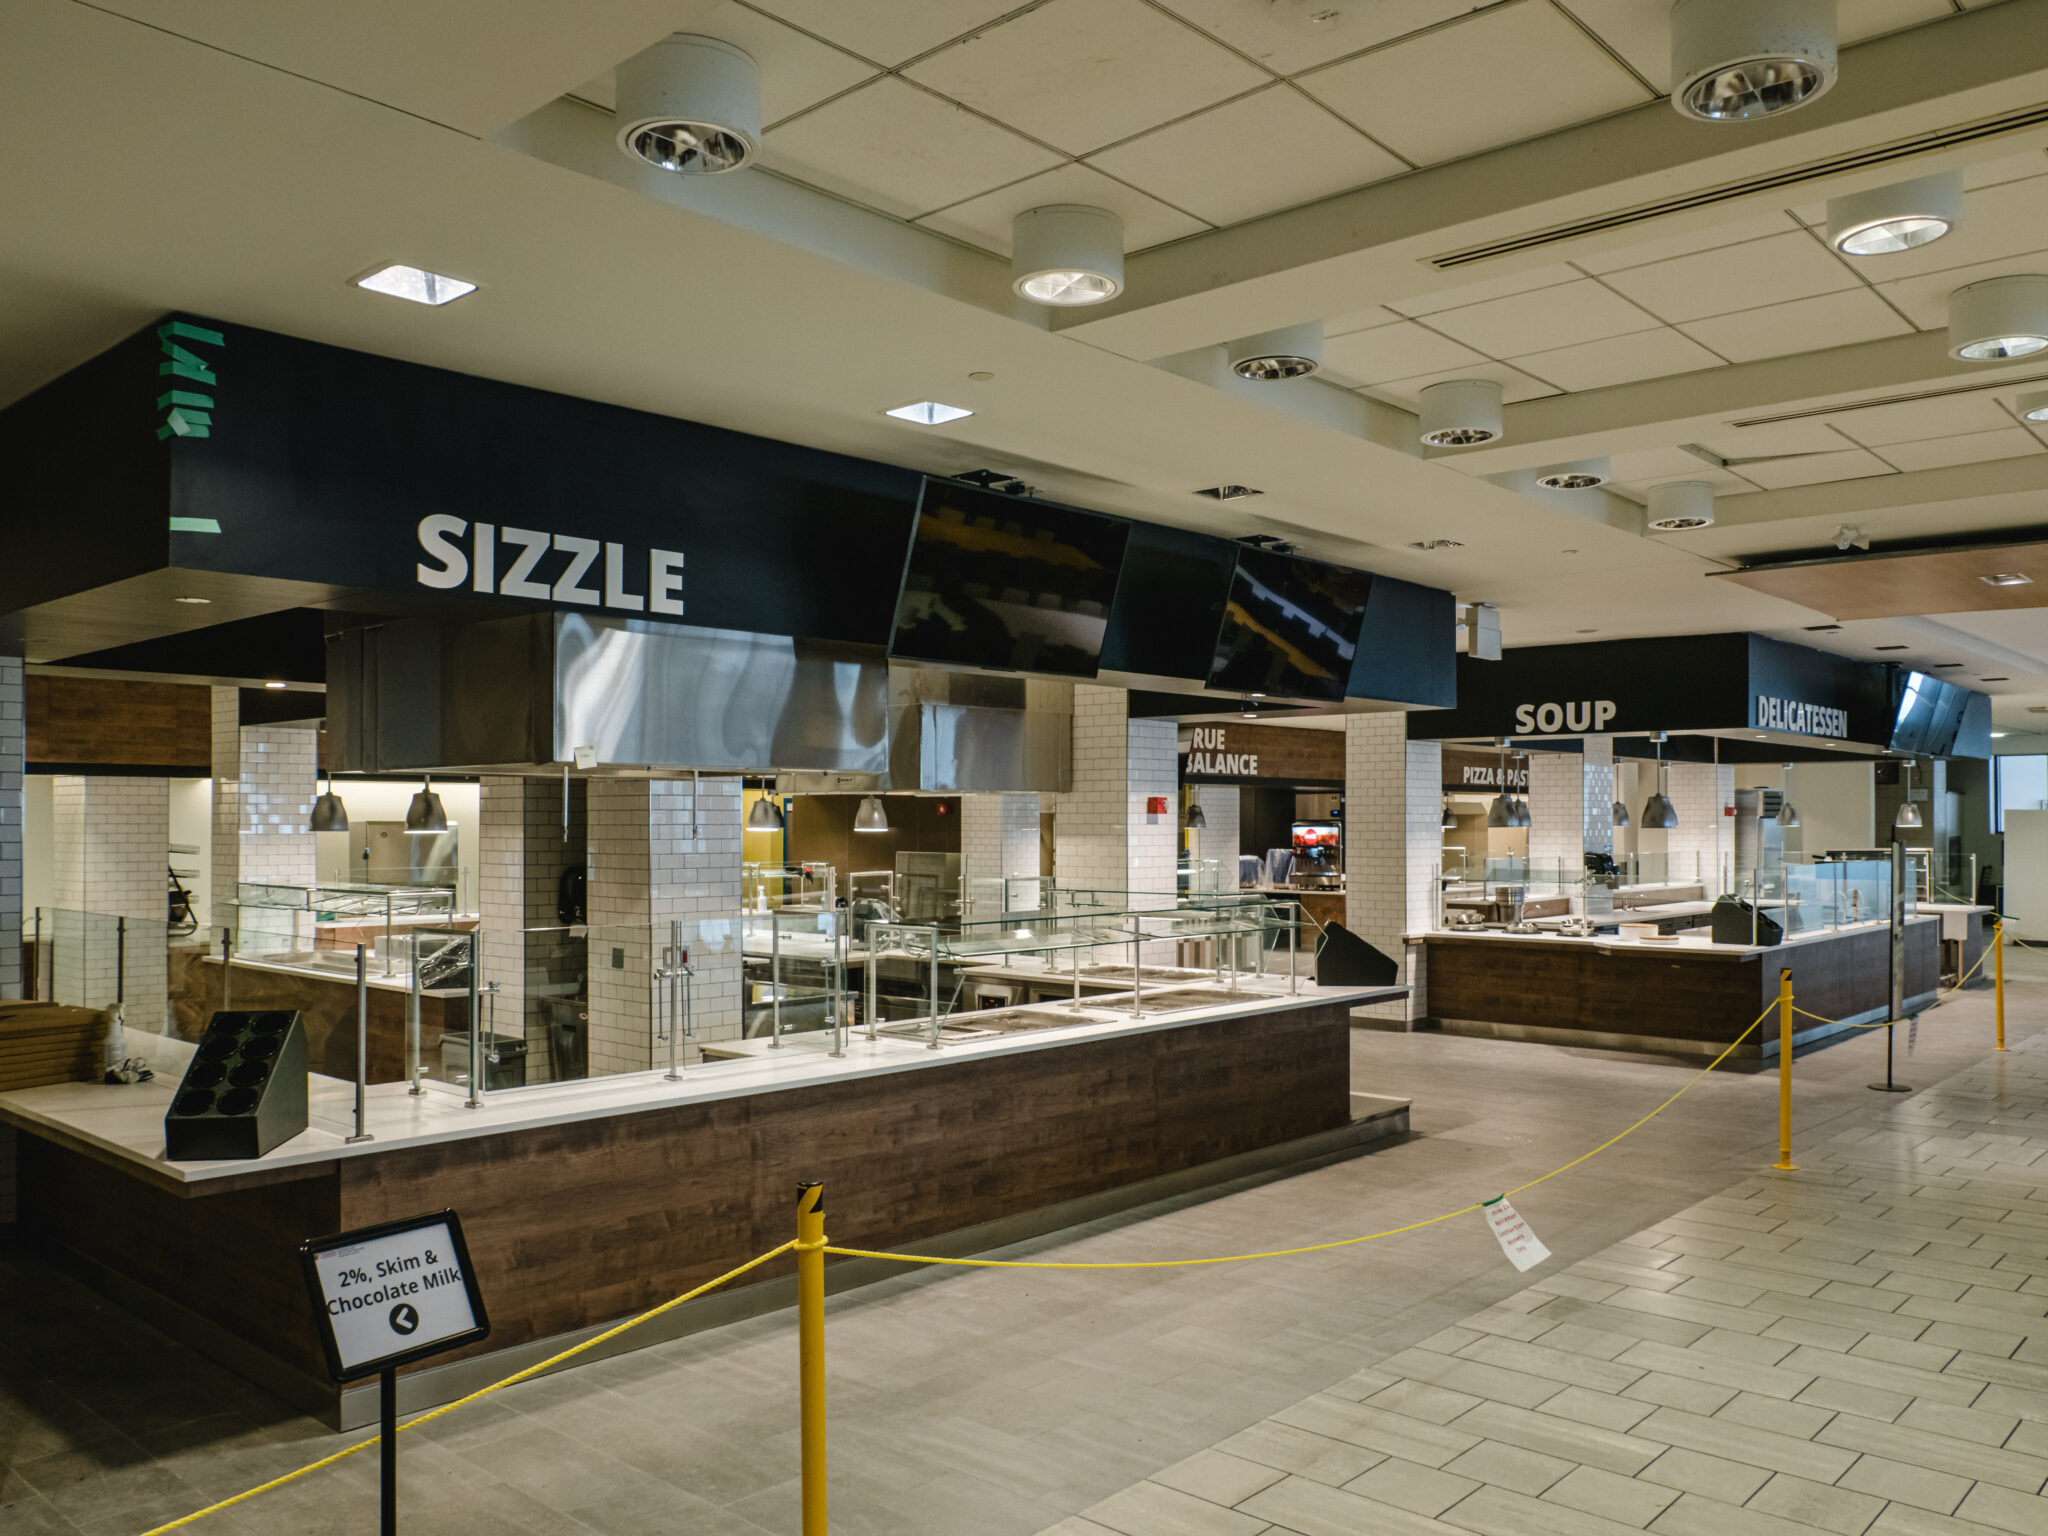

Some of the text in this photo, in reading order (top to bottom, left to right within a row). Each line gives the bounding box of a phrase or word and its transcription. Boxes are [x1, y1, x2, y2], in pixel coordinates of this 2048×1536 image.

[417, 513, 685, 616] SIZZLE
[1515, 700, 1617, 734] SOUP
[1758, 695, 1848, 738] DELICATESSEN
[1193, 727, 1226, 750] RUE
[1463, 766, 1529, 786] PIZZA & PAS
[338, 1249, 438, 1288] 2%, Skim &
[328, 1267, 462, 1315] Chocolate Milk
